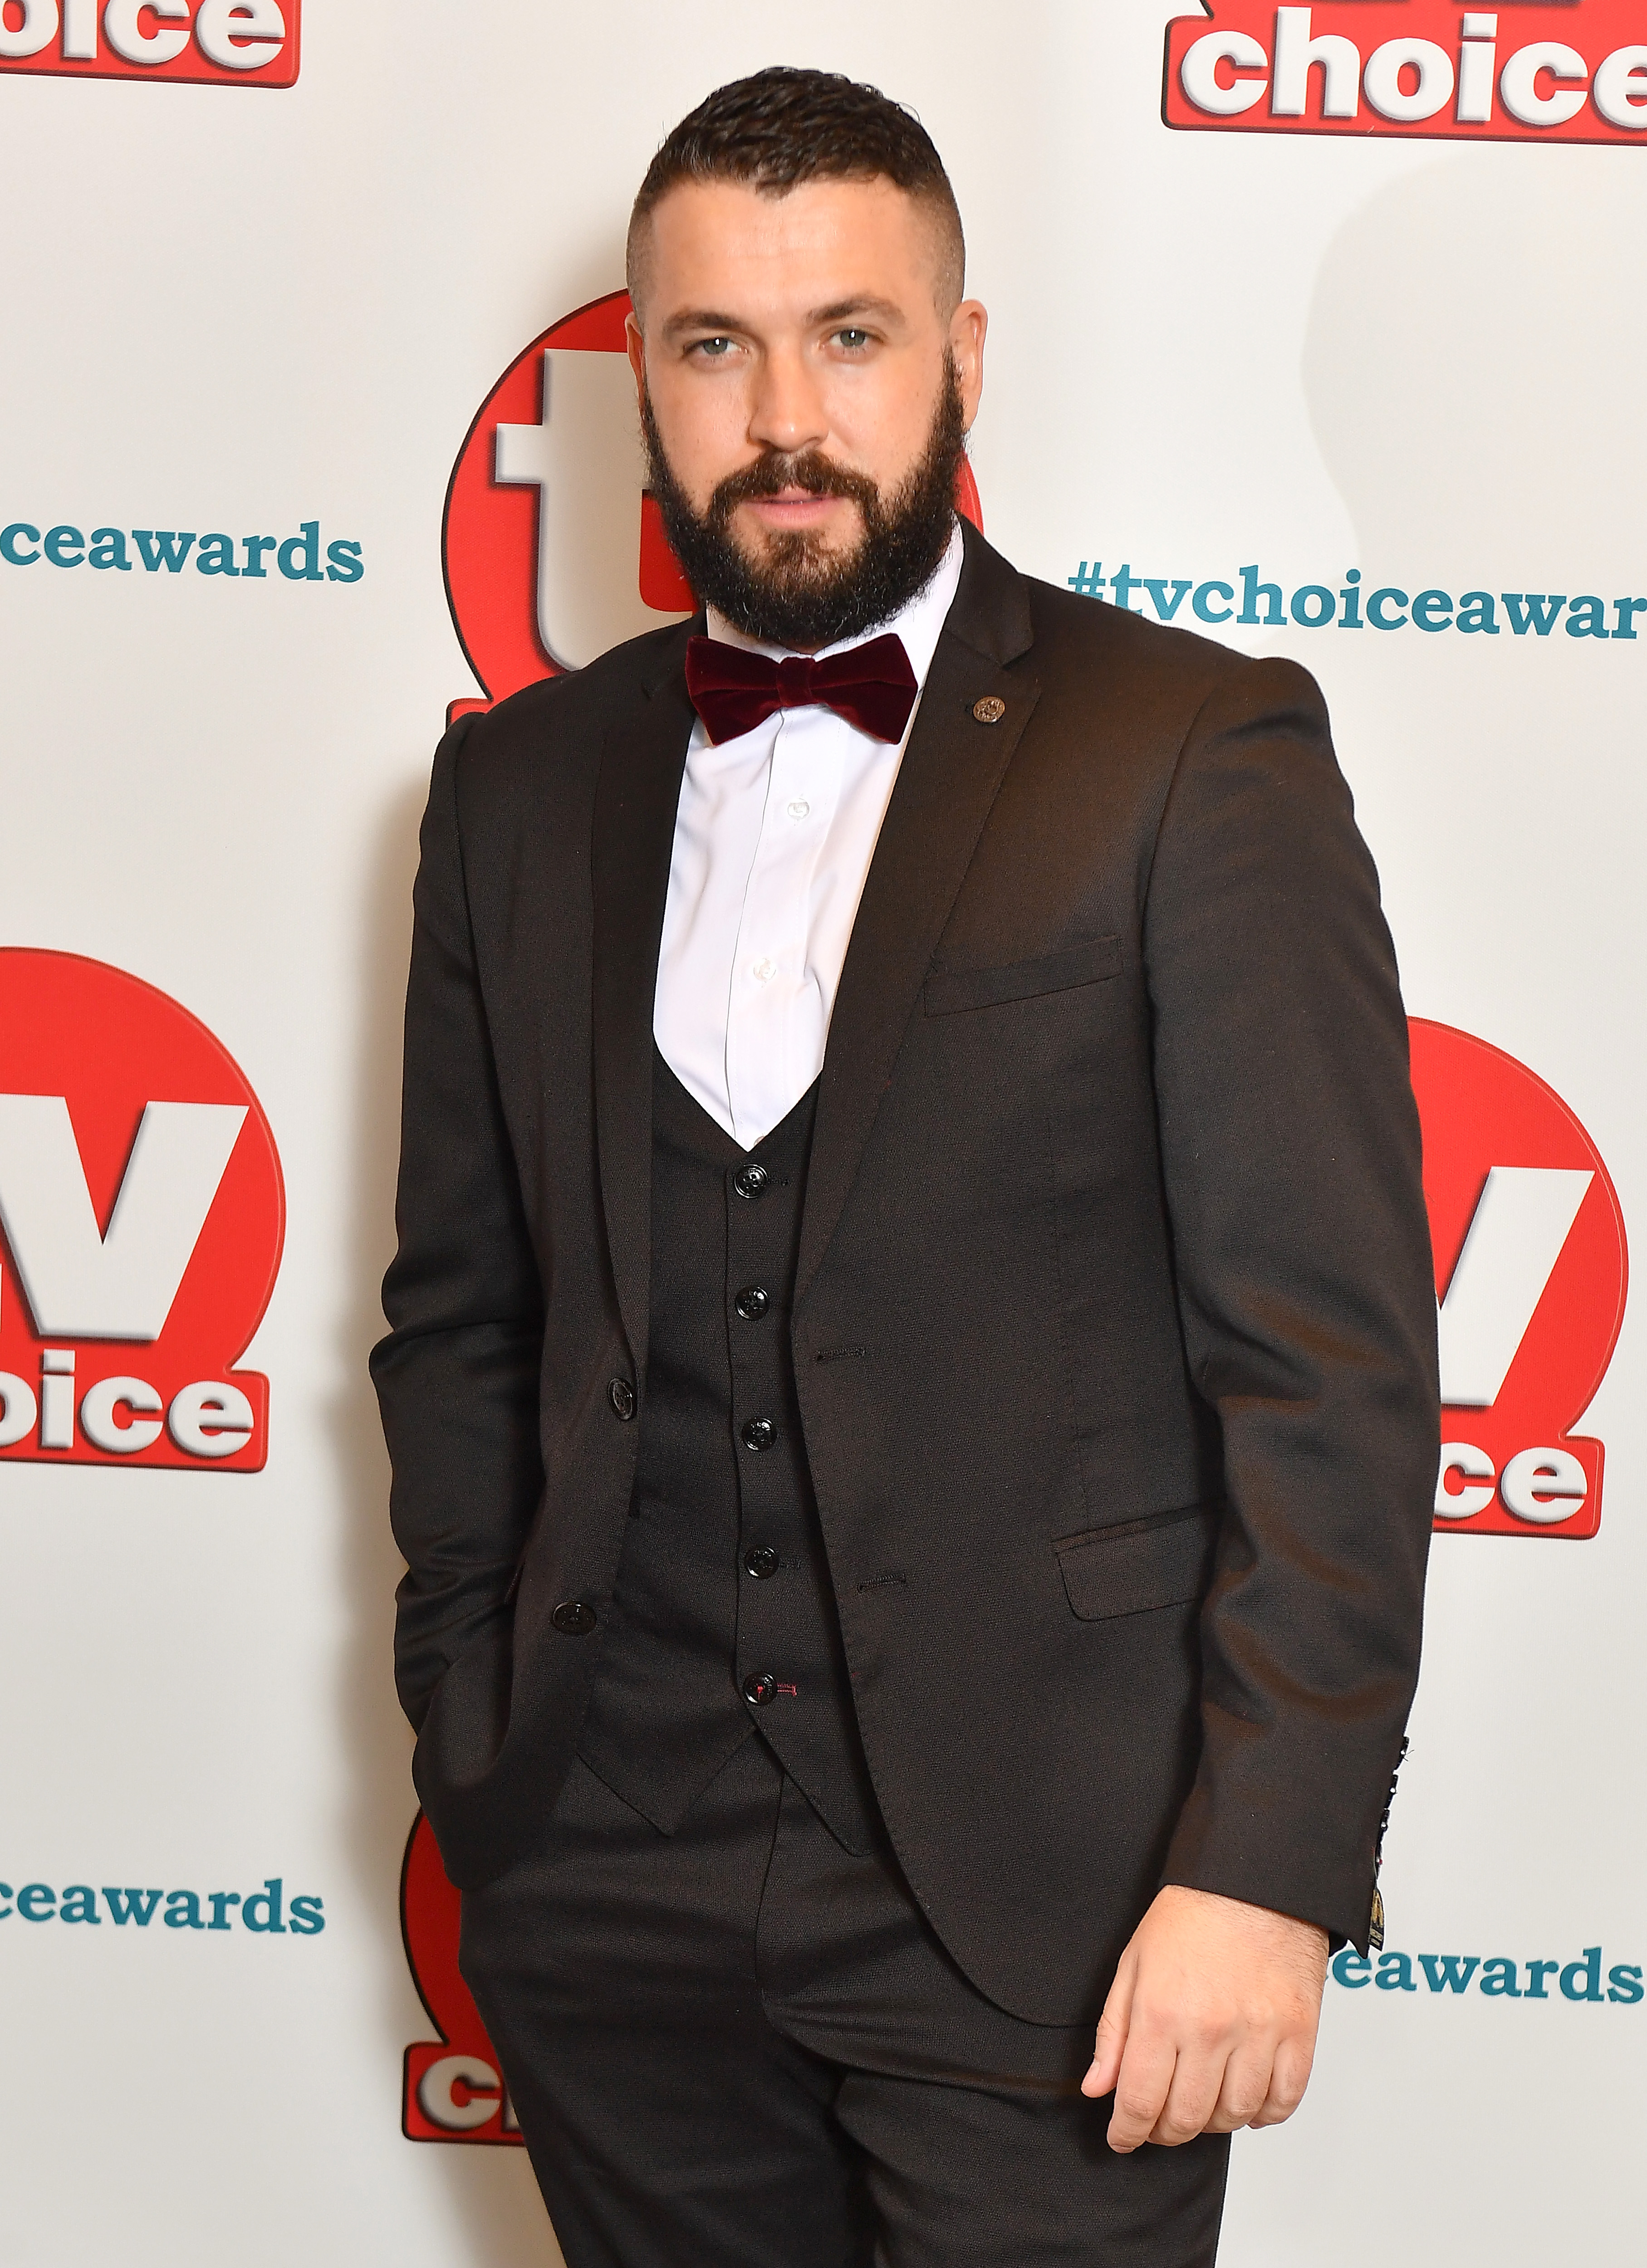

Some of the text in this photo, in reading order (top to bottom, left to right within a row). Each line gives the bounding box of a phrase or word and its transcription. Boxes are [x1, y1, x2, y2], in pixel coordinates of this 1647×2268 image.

[1181, 6, 1647, 129] choice
[0, 521, 364, 583] ceawards
[1068, 561, 1647, 640] #tvchoiceawar
[0, 1094, 249, 1340] v
[1326, 1947, 1645, 2004] eawards
